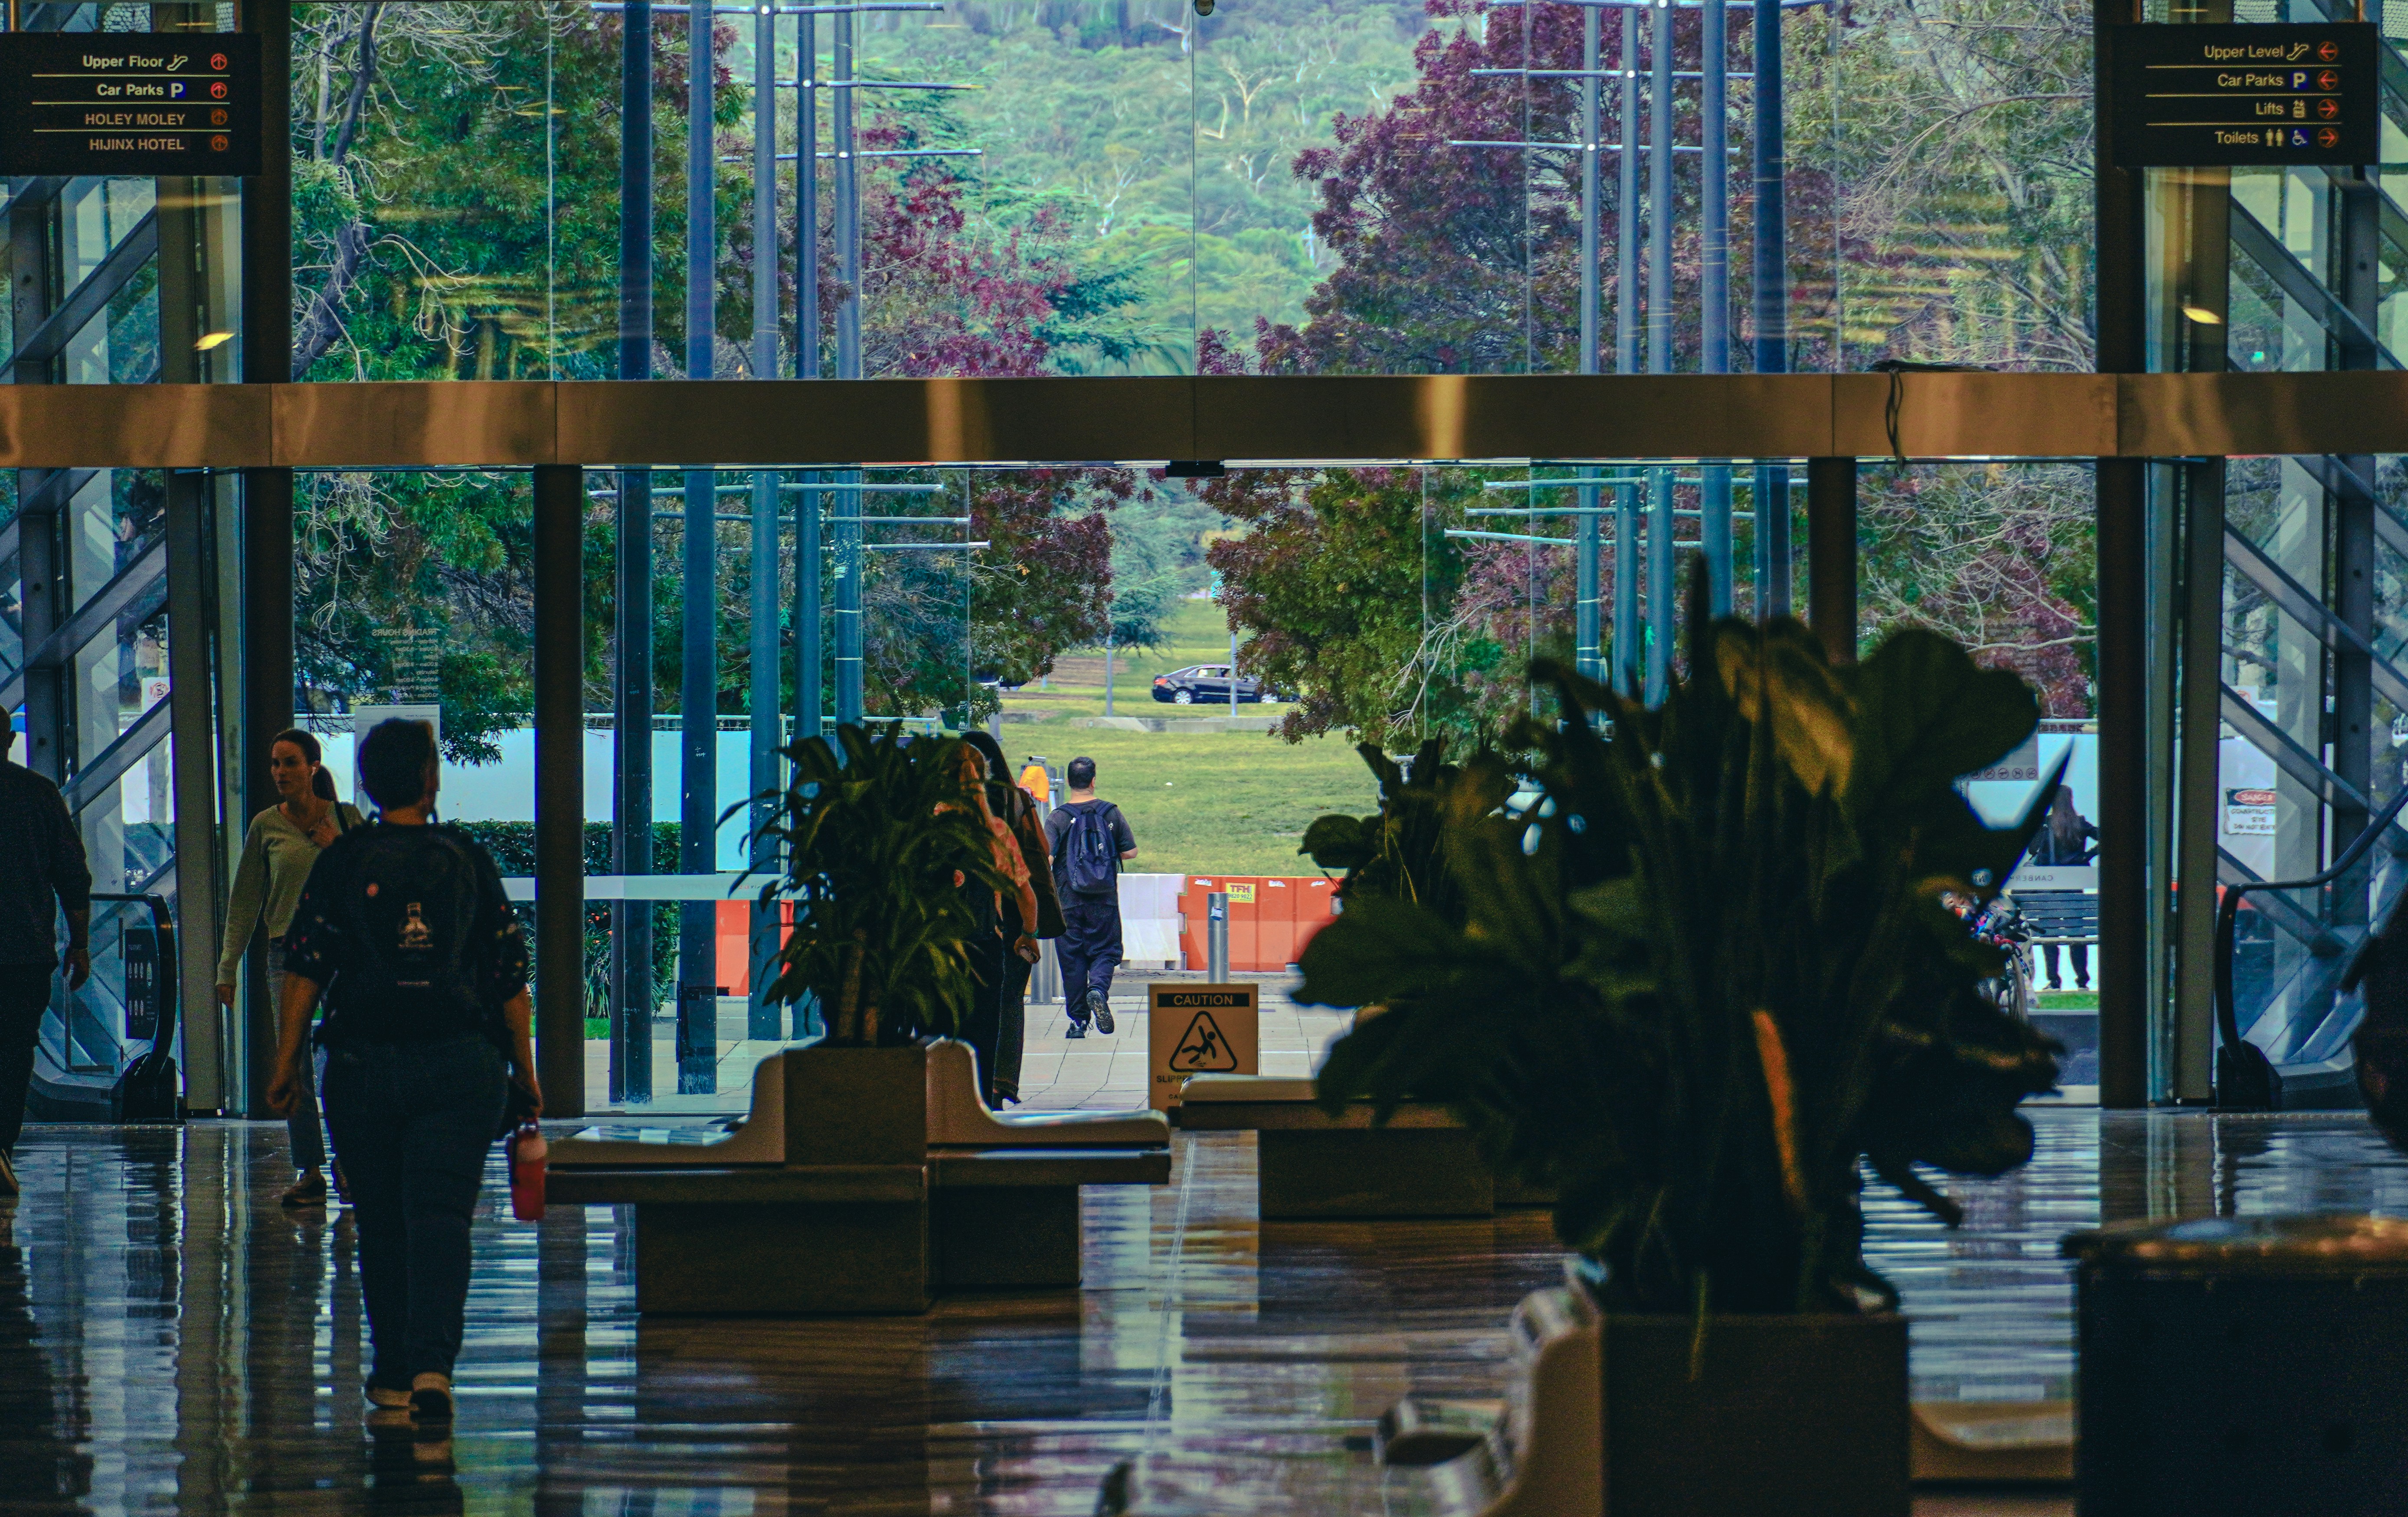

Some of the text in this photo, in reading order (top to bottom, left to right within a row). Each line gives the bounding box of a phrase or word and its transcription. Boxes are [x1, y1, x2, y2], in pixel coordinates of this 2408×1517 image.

[2204, 45, 2284, 59] Upper Level
[83, 55, 164, 69] Upper Floor
[2217, 73, 2306, 88] Car Parks P
[97, 83, 183, 98] Car Parks P
[2256, 102, 2284, 115] Lifts
[85, 113, 185, 125] HOLEY MOLEY
[2215, 131, 2259, 144] Toilets
[89, 138, 185, 151] HIJINX HOTEL
[1173, 995, 1233, 1006] CAUTION
